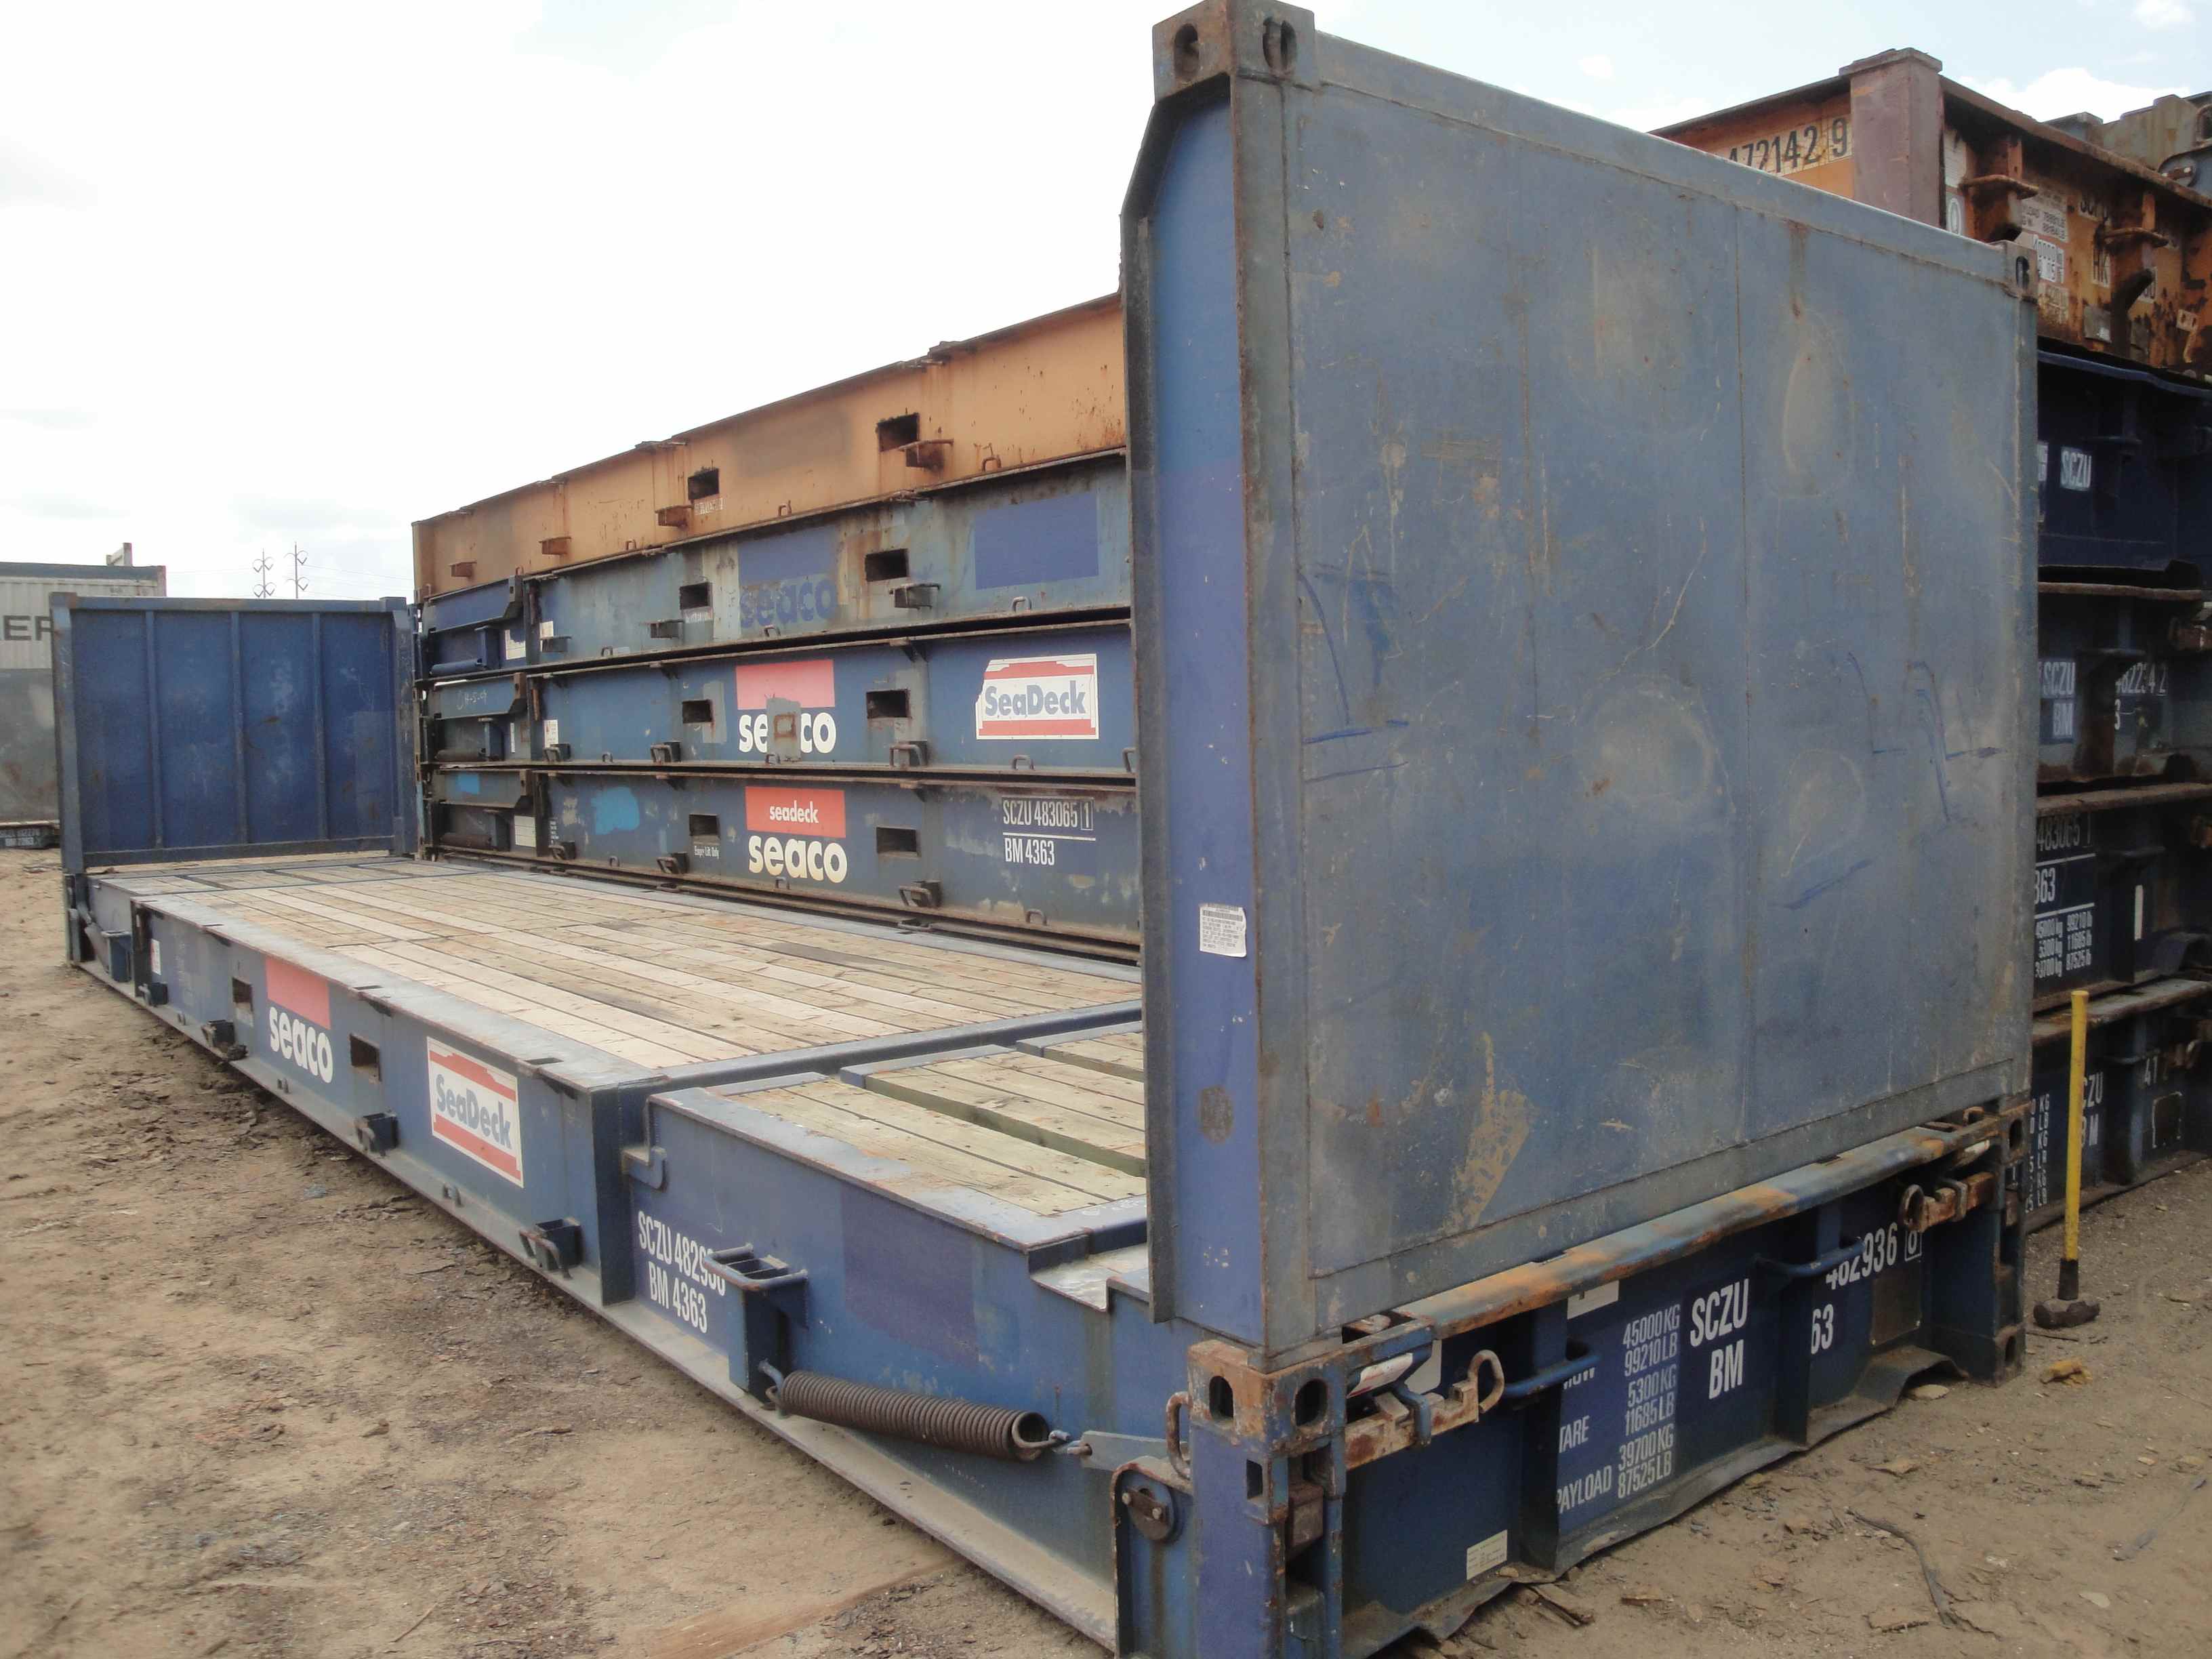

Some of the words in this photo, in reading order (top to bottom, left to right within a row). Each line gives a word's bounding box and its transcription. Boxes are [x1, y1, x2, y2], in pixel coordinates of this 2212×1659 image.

[1832, 118, 1847, 157] 9
[2061, 450, 2092, 488] SCZU
[740, 579, 838, 628] seaco
[985, 680, 1086, 716] SeaDeck
[2043, 661, 2076, 695] SCZU
[739, 712, 836, 754] seco
[770, 800, 819, 823] seadeck
[1003, 800, 1031, 825] SCZU
[1034, 801, 1078, 827] 483065
[749, 835, 848, 883] seaco
[1004, 838, 1024, 863] BM
[1025, 839, 1055, 865] 4363
[268, 1006, 333, 1084] seaco
[435, 1073, 512, 1149] SeaDeck
[638, 1210, 672, 1265] SCZU
[649, 1261, 670, 1309] BM
[673, 1277, 708, 1334] 4363
[1690, 1278, 1750, 1347] SCZU
[1622, 1311, 1661, 1349] 45000
[1662, 1303, 1681, 1336] KG
[1624, 1338, 1660, 1377] 99210
[1662, 1332, 1678, 1365] LB
[1708, 1338, 1744, 1399] BM
[1811, 1304, 1834, 1355] 63
[1627, 1371, 1660, 1408] 5300
[1660, 1364, 1677, 1395] KG
[1559, 1415, 1590, 1454] TARE
[1625, 1398, 1658, 1437] 11685
[1659, 1391, 1675, 1424] LB
[1618, 1431, 1657, 1472] 39700
[1658, 1423, 1675, 1456] KG
[1618, 1458, 1655, 1499] 87525
[1656, 1450, 1672, 1483] LB
